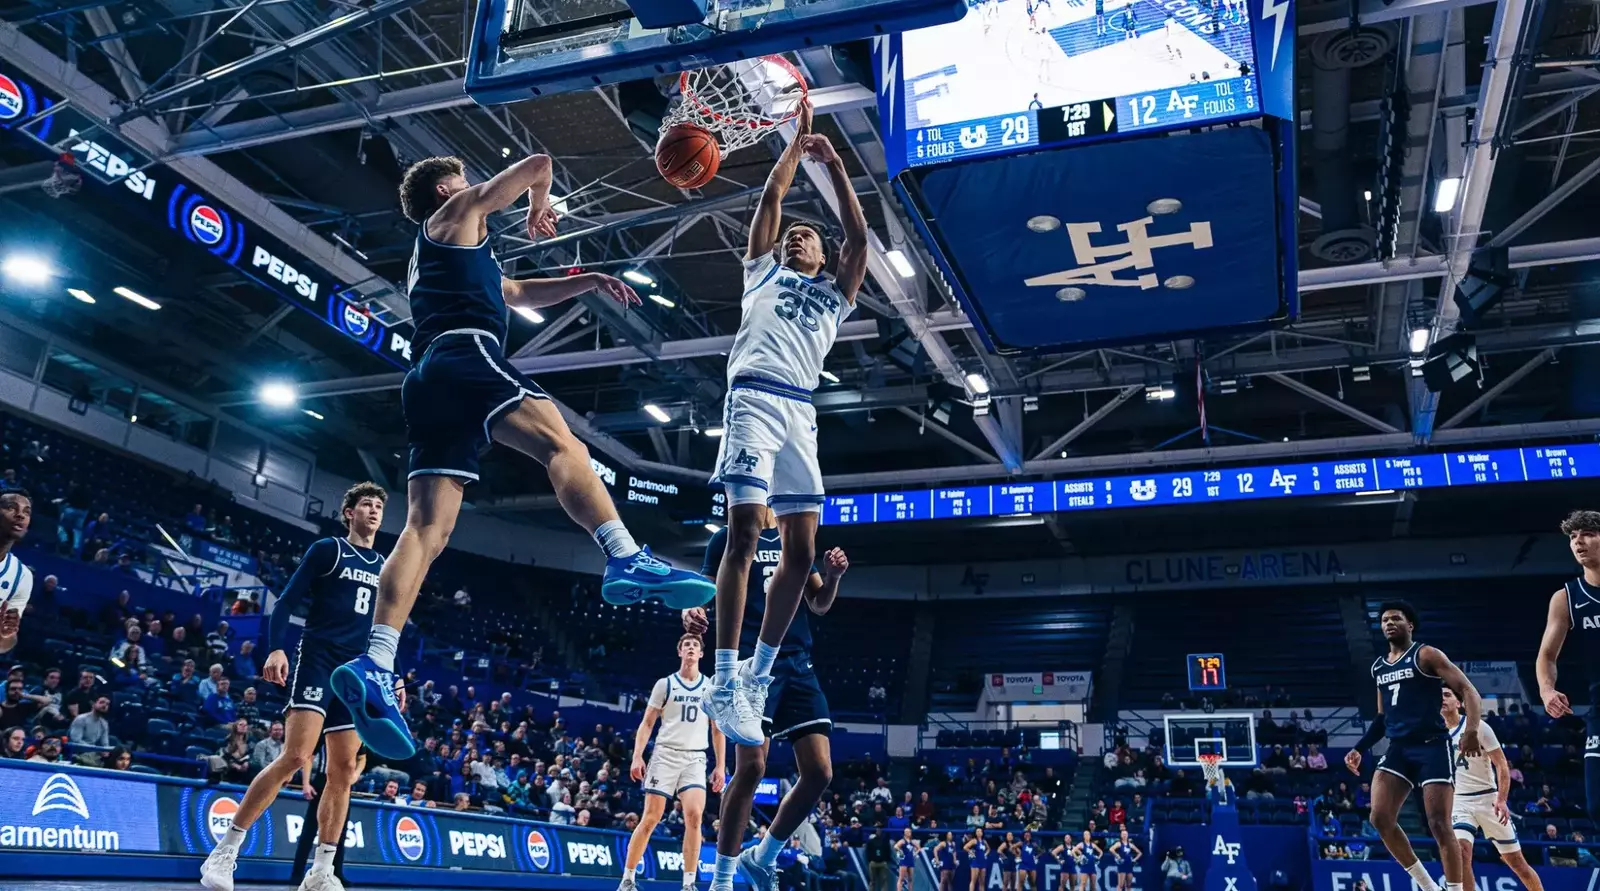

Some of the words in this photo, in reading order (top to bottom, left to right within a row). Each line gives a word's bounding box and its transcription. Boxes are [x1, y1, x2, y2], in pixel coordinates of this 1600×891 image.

[1214, 82, 1233, 97] TOL
[1244, 79, 1252, 92] 2
[1062, 103, 1091, 122] 7:29
[1128, 95, 1158, 127] 12
[1166, 90, 1199, 118] AF
[1204, 98, 1235, 115] FOULS
[1246, 95, 1254, 109] 3
[916, 130, 923, 143] 4
[927, 128, 943, 142] TOL
[1001, 116, 1029, 145] 29
[1067, 121, 1086, 137] 1ST
[917, 147, 924, 158] 5
[927, 142, 955, 157] FOULS
[69, 128, 156, 200] PEPSI
[194, 214, 220, 235] PEPSI
[252, 245, 319, 302] PEPSI
[774, 275, 797, 289] AIR
[798, 281, 840, 314] FORCE
[774, 290, 825, 332] 35
[735, 448, 758, 472] AF
[1536, 449, 1543, 458] 11
[1545, 449, 1568, 457] Brown
[1548, 458, 1562, 466] PTS
[1203, 471, 1221, 482] 7:29
[1312, 466, 1319, 477] 3
[1333, 463, 1367, 475] ASSISTS
[1495, 472, 1499, 481] 1
[628, 476, 678, 495] Dartmouth
[1064, 482, 1094, 494] ASSISTS
[1172, 477, 1192, 497] 29
[1236, 473, 1254, 493] 12
[1269, 468, 1297, 494] AF
[1313, 480, 1320, 491] 0
[1335, 477, 1364, 489] STEALS
[628, 490, 658, 505] Brown
[712, 493, 725, 504] 40
[1068, 495, 1094, 507] STEALS
[1207, 486, 1219, 497] 1ST
[712, 505, 724, 516] 52
[1125, 556, 1225, 585] CLUNE
[1242, 550, 1342, 580] ARENA
[354, 586, 372, 615] 8
[1006, 676, 1033, 684] TOYOTA
[1203, 668, 1218, 685] 17
[1376, 667, 1414, 686] AGGIES
[1388, 683, 1401, 706] 7
[681, 704, 698, 722] 10
[1456, 754, 1469, 770] 4
[0, 825, 119, 850] amentum
[286, 814, 364, 848] PSI
[449, 830, 506, 858] PEPSI
[1212, 834, 1241, 864] AF
[567, 842, 612, 866] PEPSI
